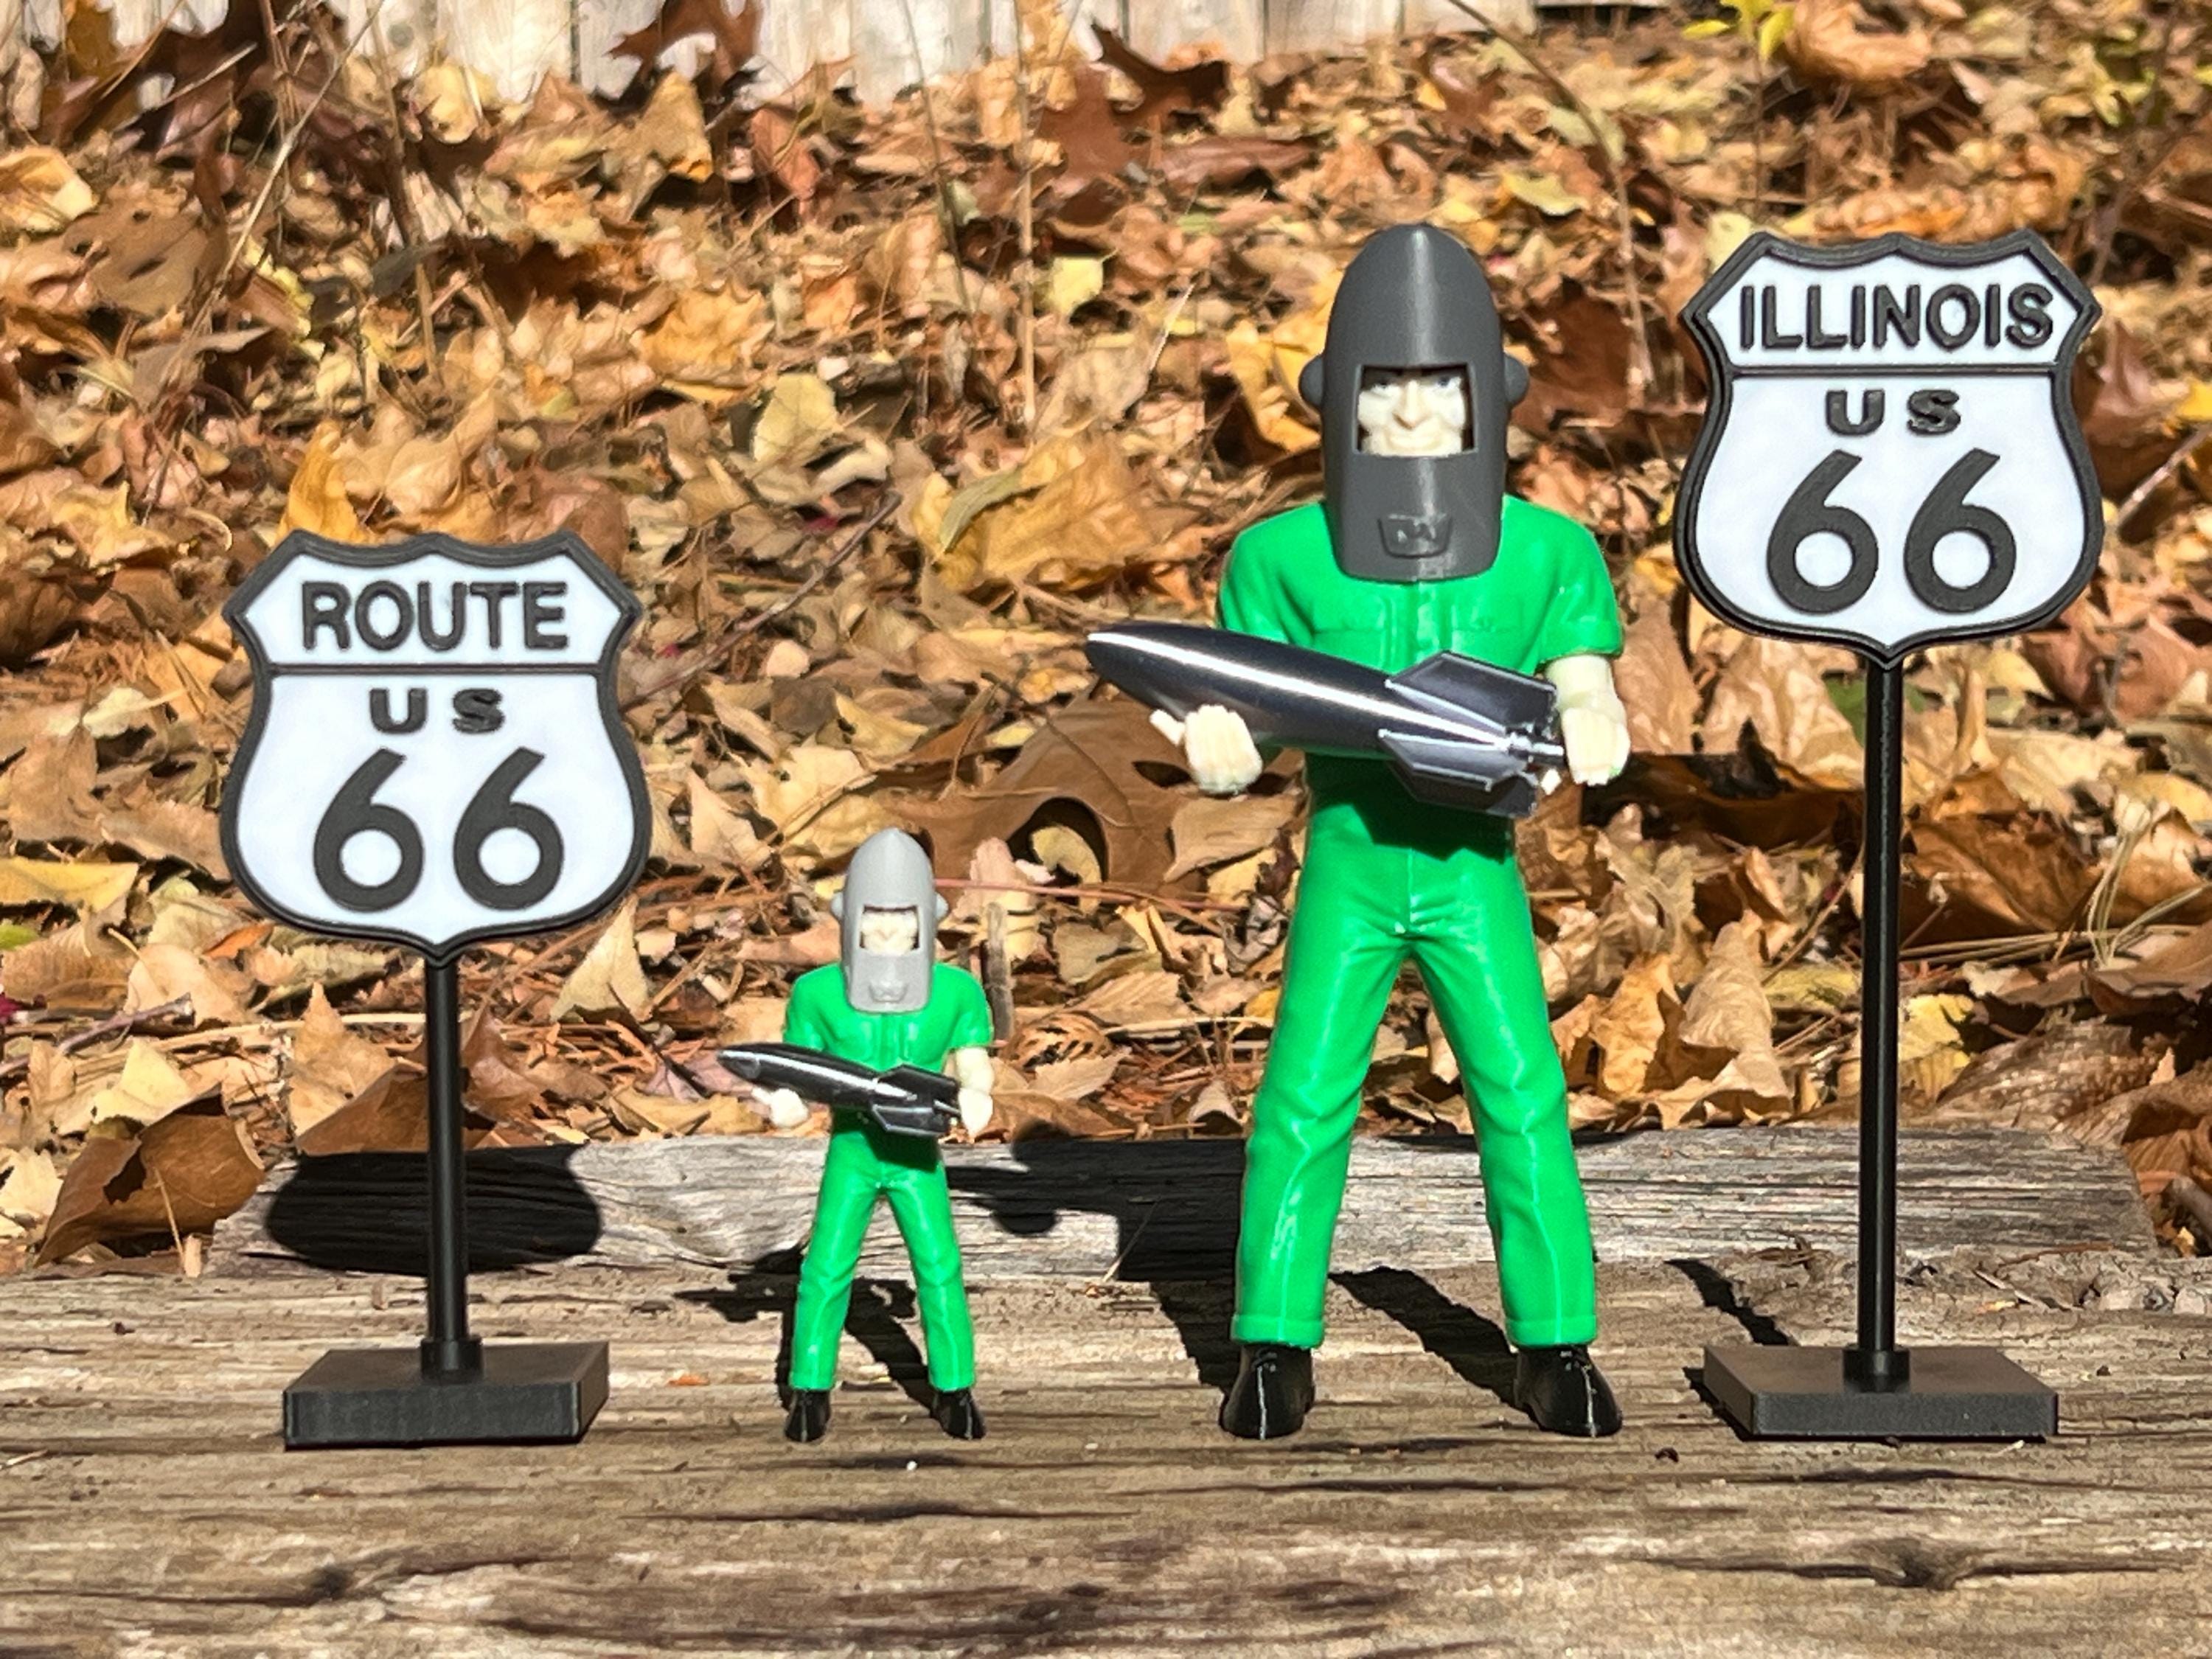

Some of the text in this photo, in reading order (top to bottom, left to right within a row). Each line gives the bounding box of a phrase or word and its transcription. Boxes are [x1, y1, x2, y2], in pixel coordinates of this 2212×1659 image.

[1739, 282, 2055, 352] ILLINOIS
[1824, 388, 1962, 438] US
[1766, 447, 2017, 615] 66
[301, 579, 570, 653] ROUTE
[368, 687, 506, 735] US
[312, 746, 565, 914] 66
